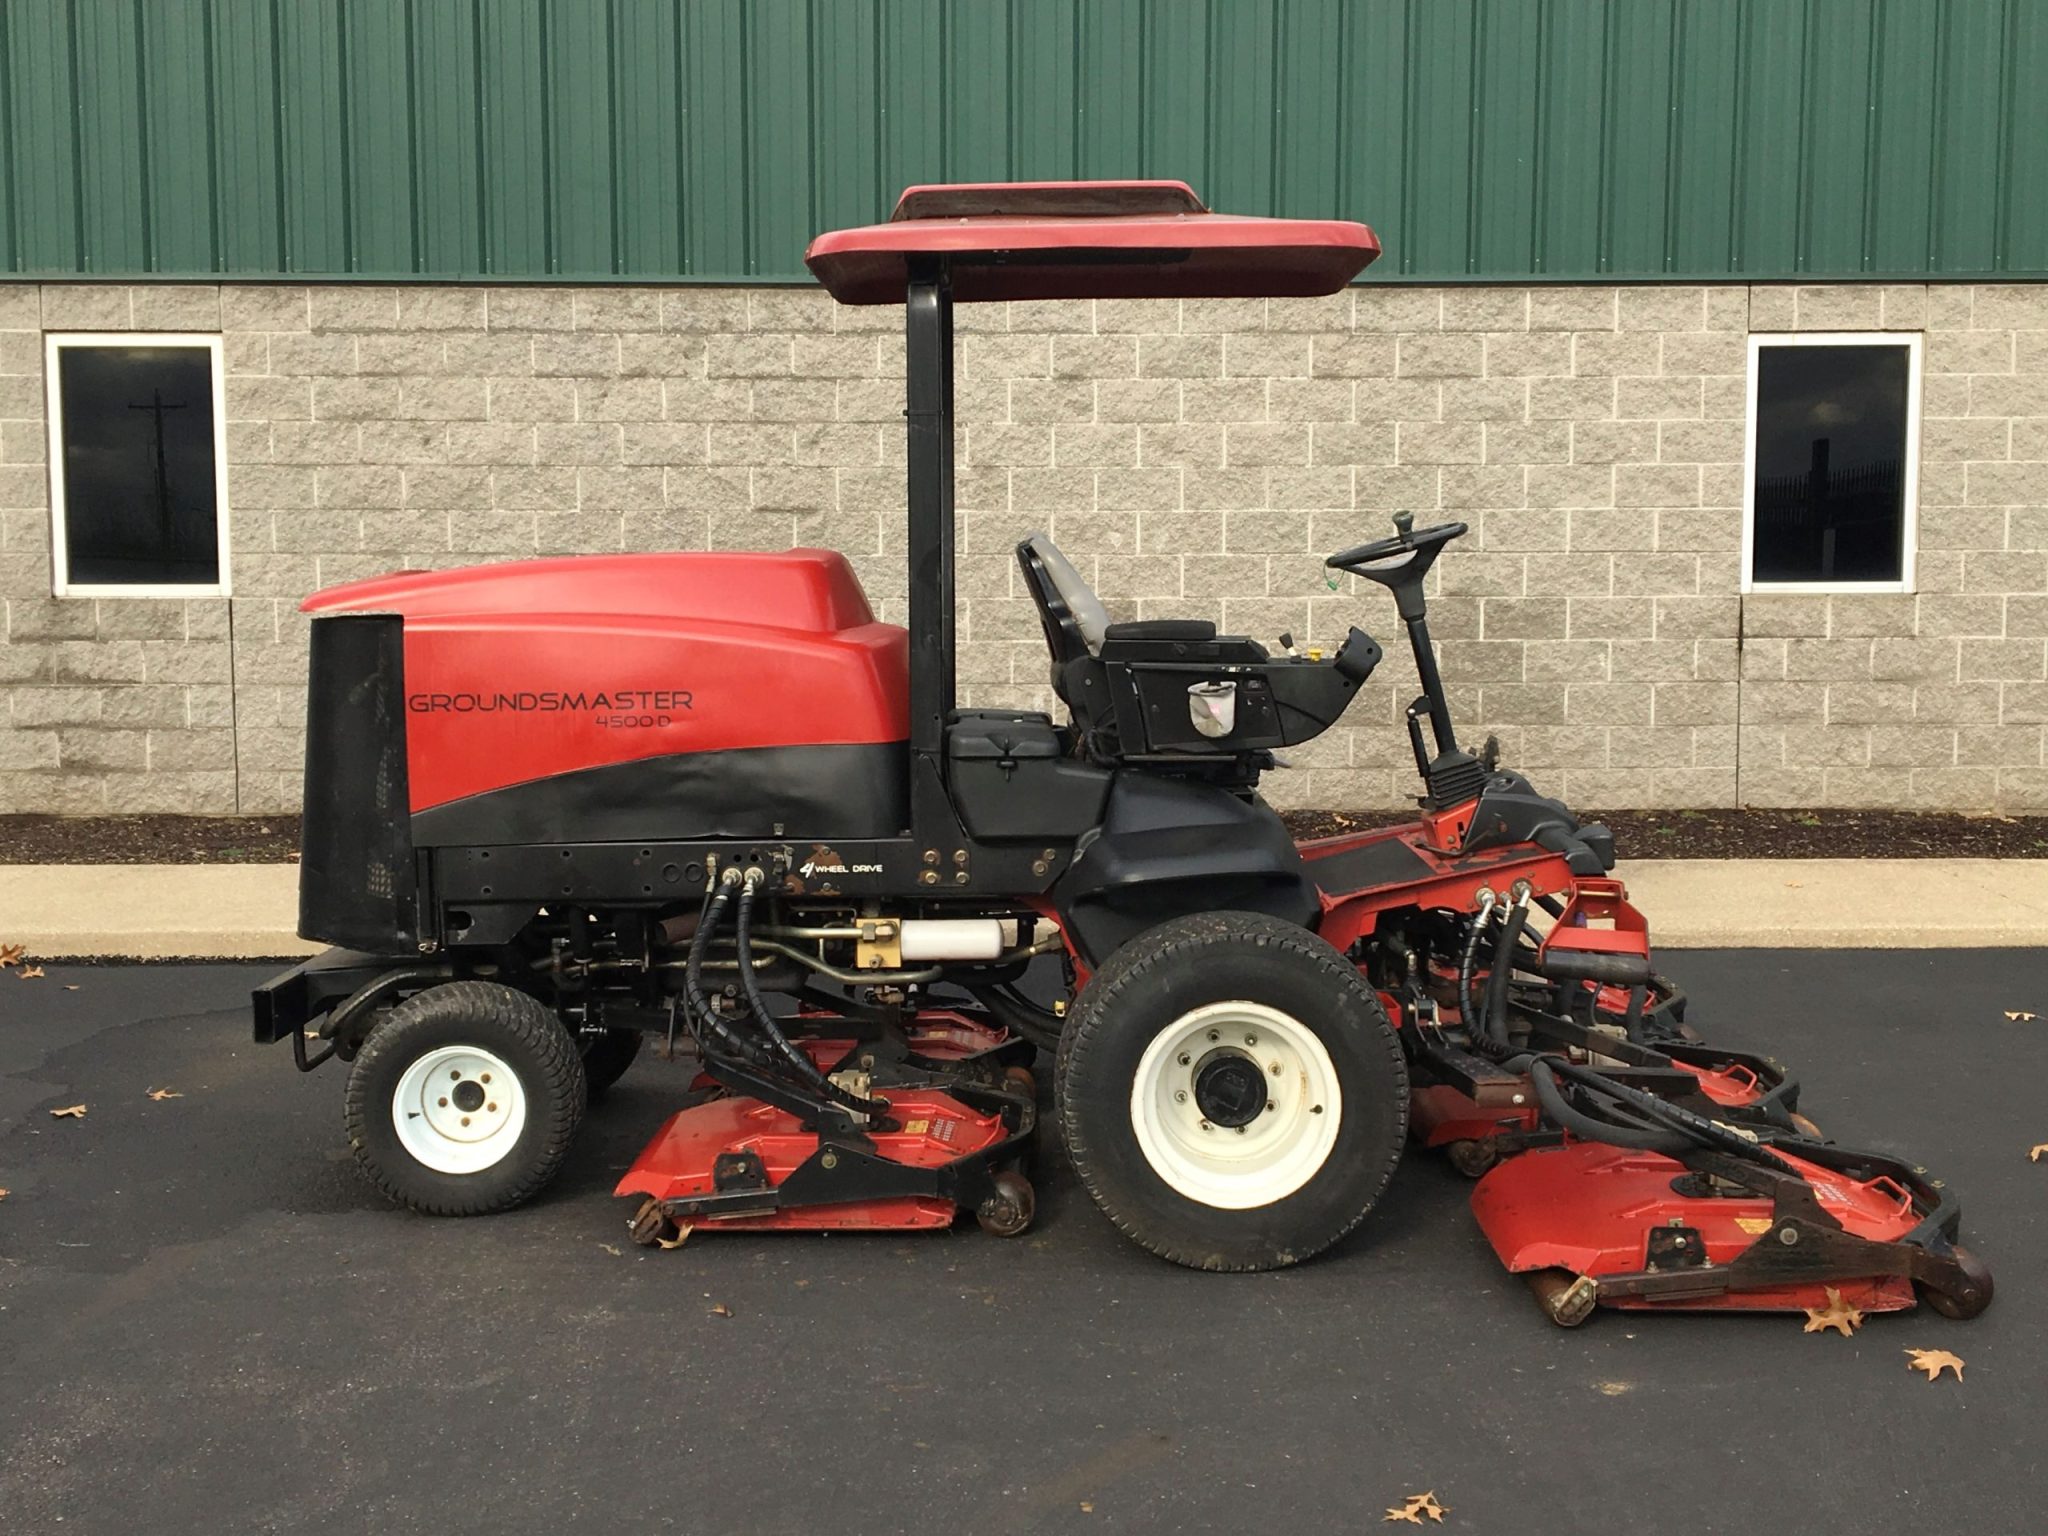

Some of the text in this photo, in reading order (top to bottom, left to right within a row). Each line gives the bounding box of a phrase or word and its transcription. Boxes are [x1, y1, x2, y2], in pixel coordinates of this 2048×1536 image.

[409, 691, 693, 712] GROUNDSMASTER
[800, 862, 883, 878] 4 WHEEL DRIVE
